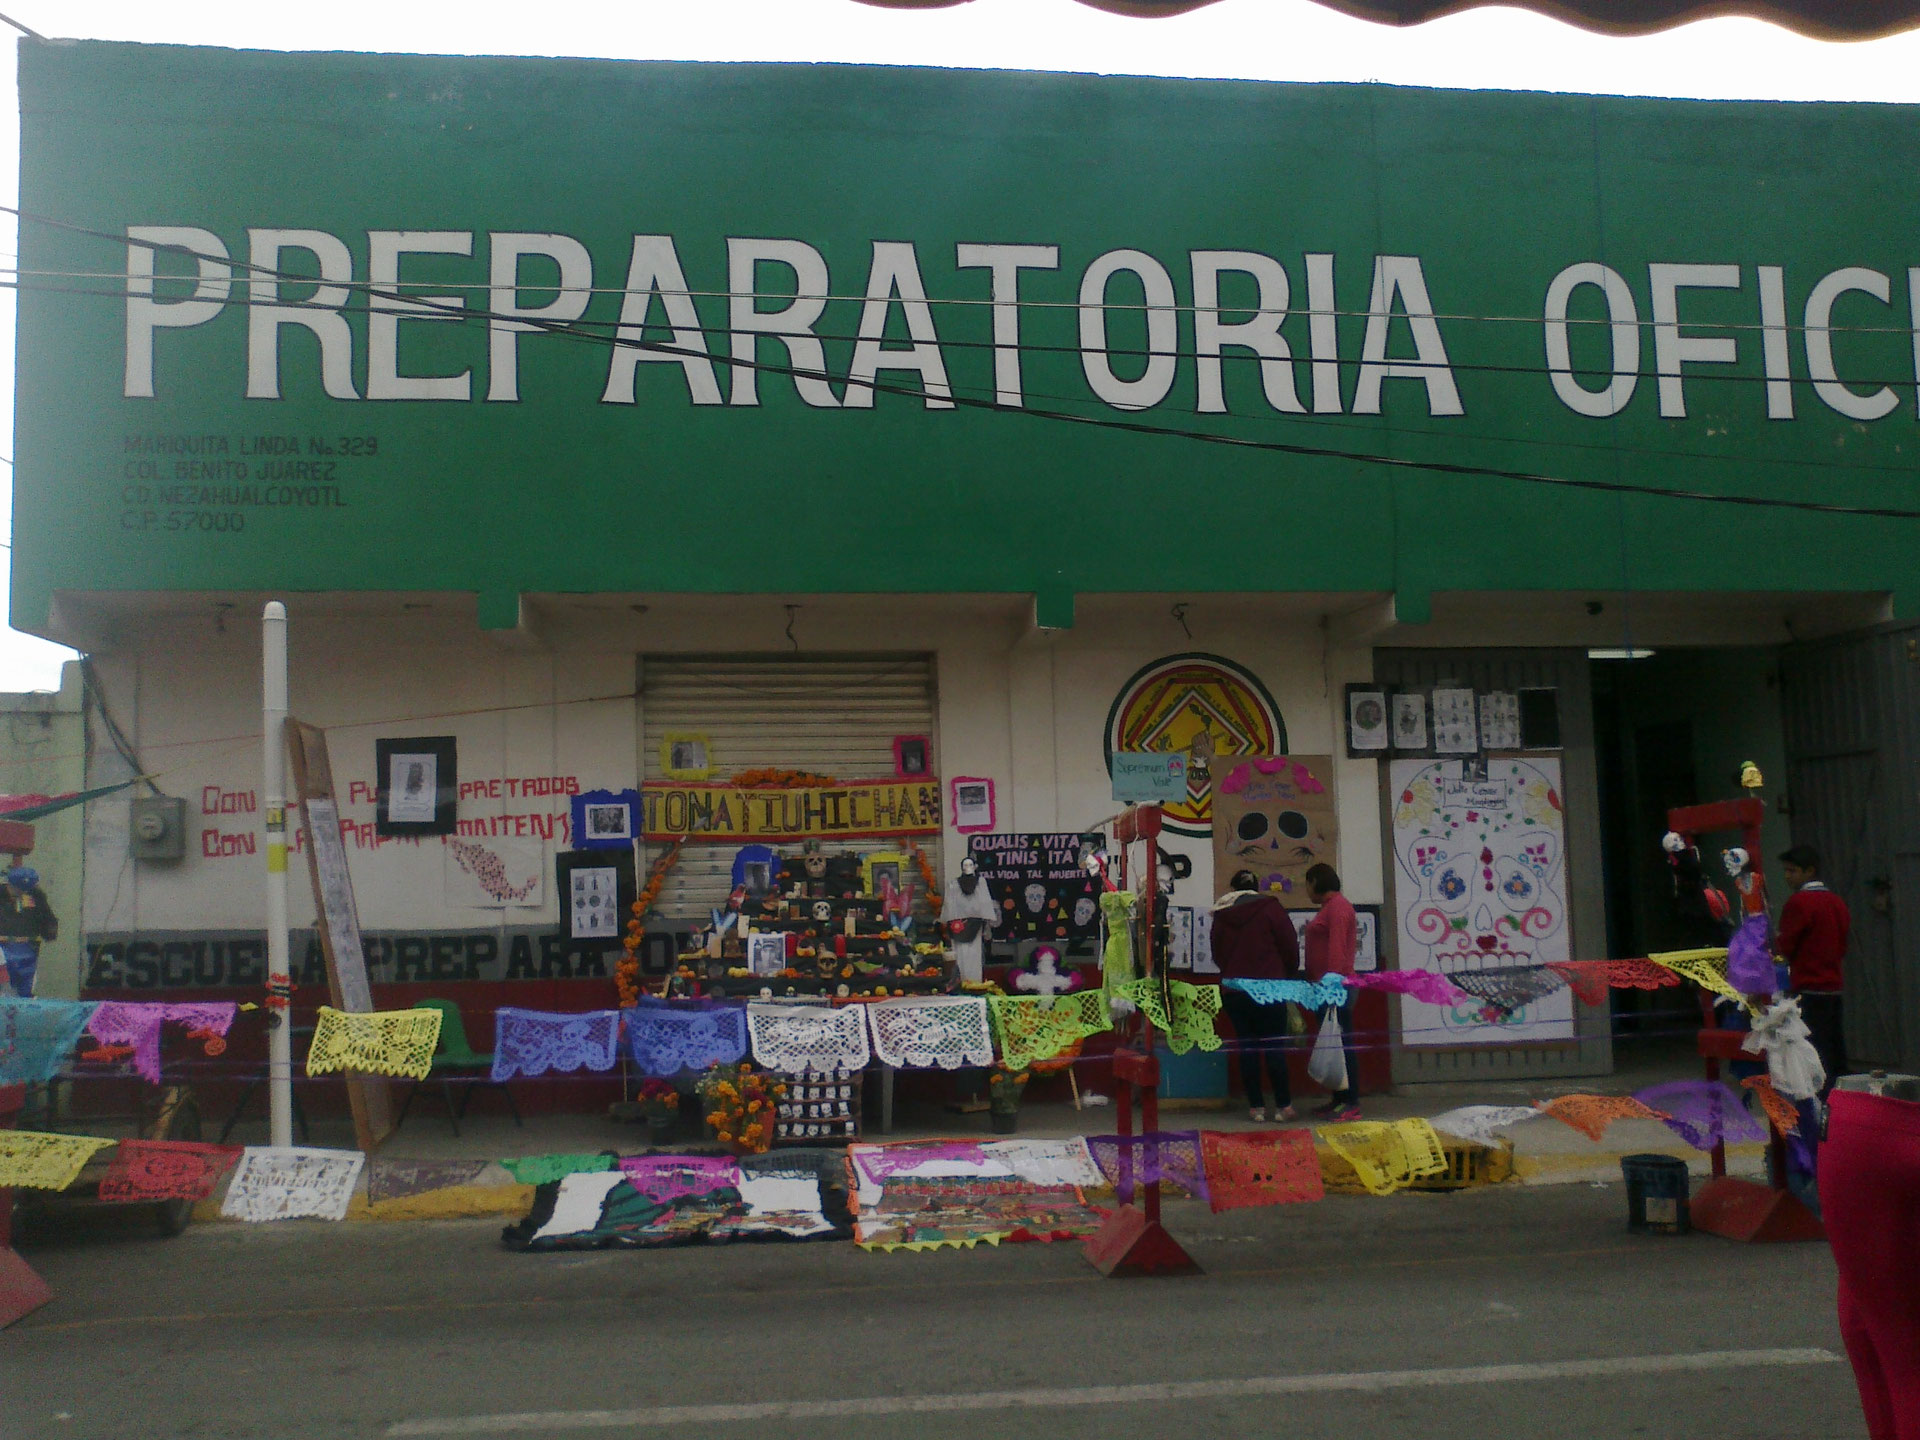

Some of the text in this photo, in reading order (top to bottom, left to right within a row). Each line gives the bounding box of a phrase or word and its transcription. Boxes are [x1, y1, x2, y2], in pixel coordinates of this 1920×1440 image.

[123, 225, 1466, 417] PREPARATORIA
[124, 435, 229, 455] MARIQUITA
[240, 436, 299, 456] LINDA
[175, 461, 249, 481] BENITO
[256, 461, 337, 481] JUAREZ
[159, 485, 349, 507] NEZAHUALCOYOTL
[165, 510, 246, 533] 57000
[972, 834, 1080, 851] QUALIS VITA
[1048, 849, 1074, 864] ITA
[997, 869, 1020, 880] VIDA
[1026, 869, 1043, 879] TAL
[1048, 868, 1087, 880] MUERTE
